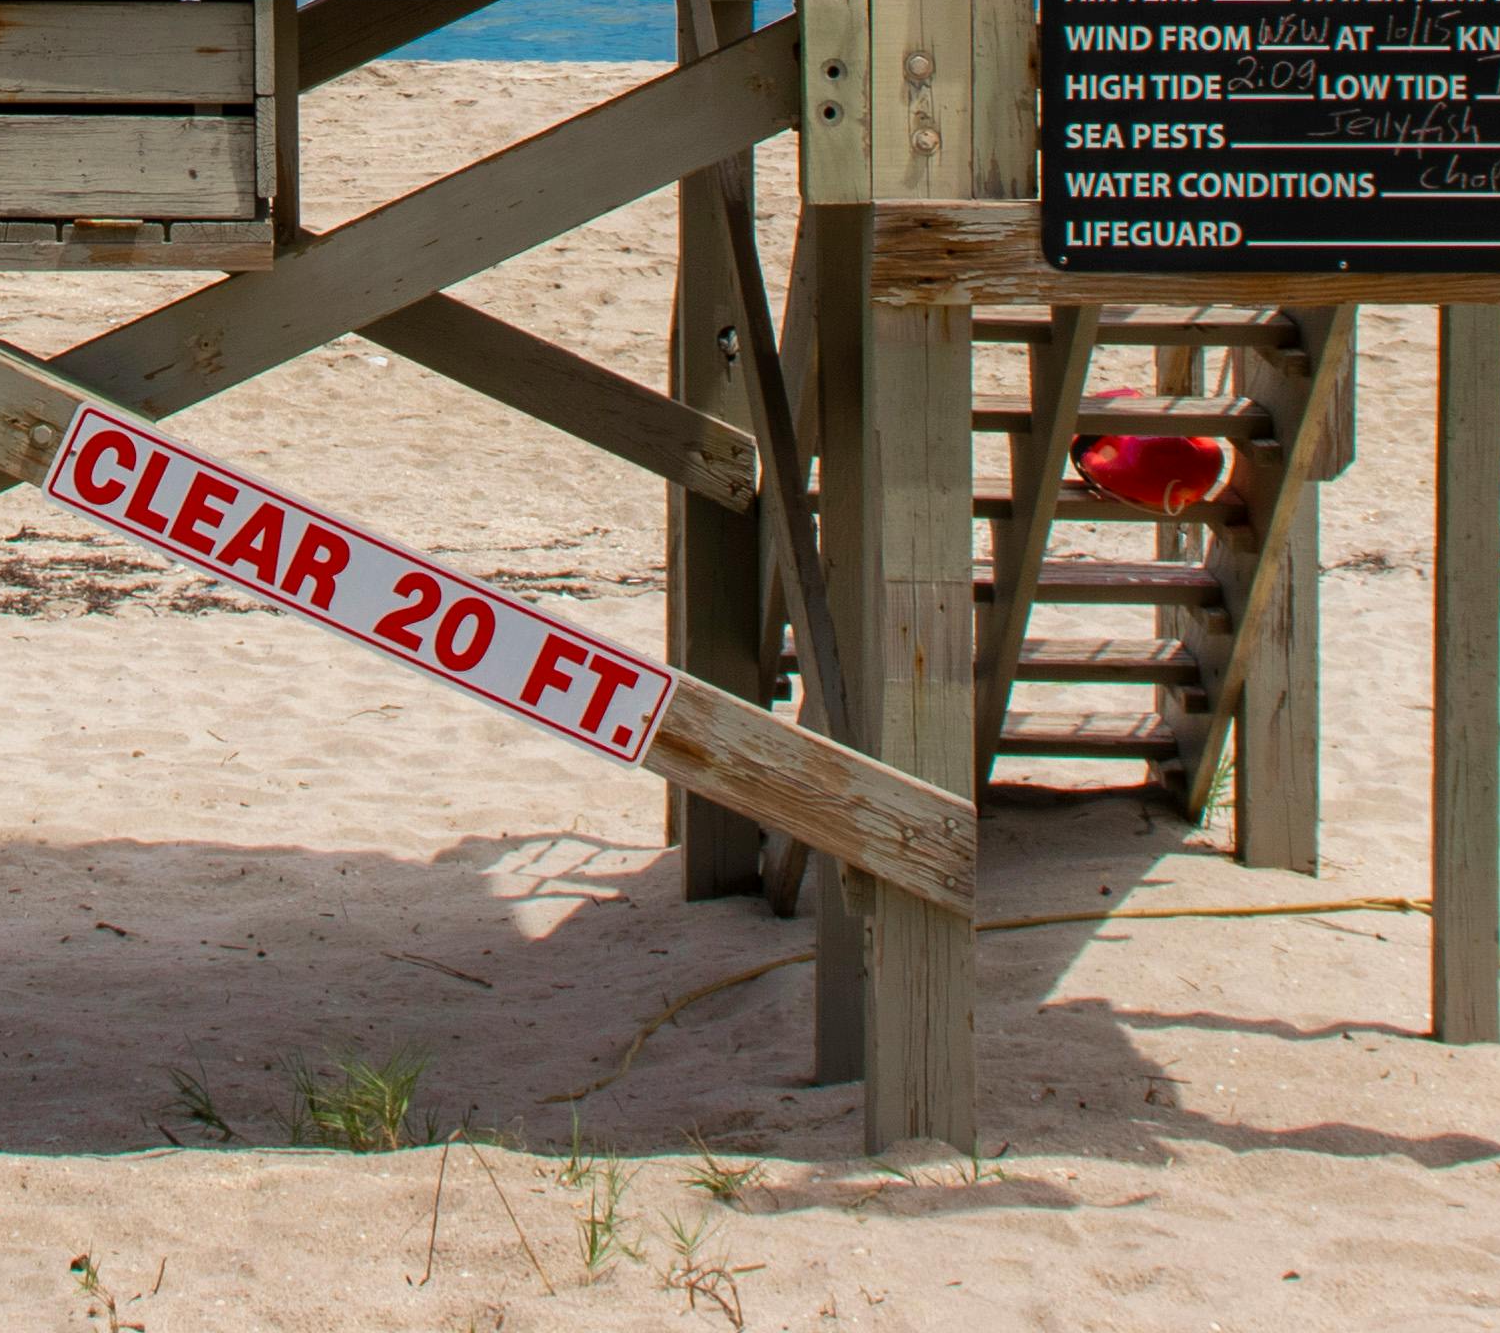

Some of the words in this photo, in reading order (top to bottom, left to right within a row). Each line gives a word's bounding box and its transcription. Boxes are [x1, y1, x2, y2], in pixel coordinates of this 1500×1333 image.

[1064, 25, 1154, 52] WIND
[1159, 25, 1253, 52] FROM
[1335, 25, 1375, 52] AT
[1065, 74, 1145, 101] HIGH
[1150, 74, 1223, 101] TIDE
[1318, 74, 1391, 101] LOW
[1395, 74, 1468, 101] TIDE
[1064, 123, 1126, 150] SEA
[1131, 123, 1227, 150] PESTS
[1064, 172, 1173, 198] WATER
[1178, 171, 1376, 199] CONDITIONS
[1065, 220, 1243, 248] LIFEGUARD
[71, 428, 352, 612] CLEAR
[372, 571, 497, 673] 20
[518, 632, 641, 749] FT.
